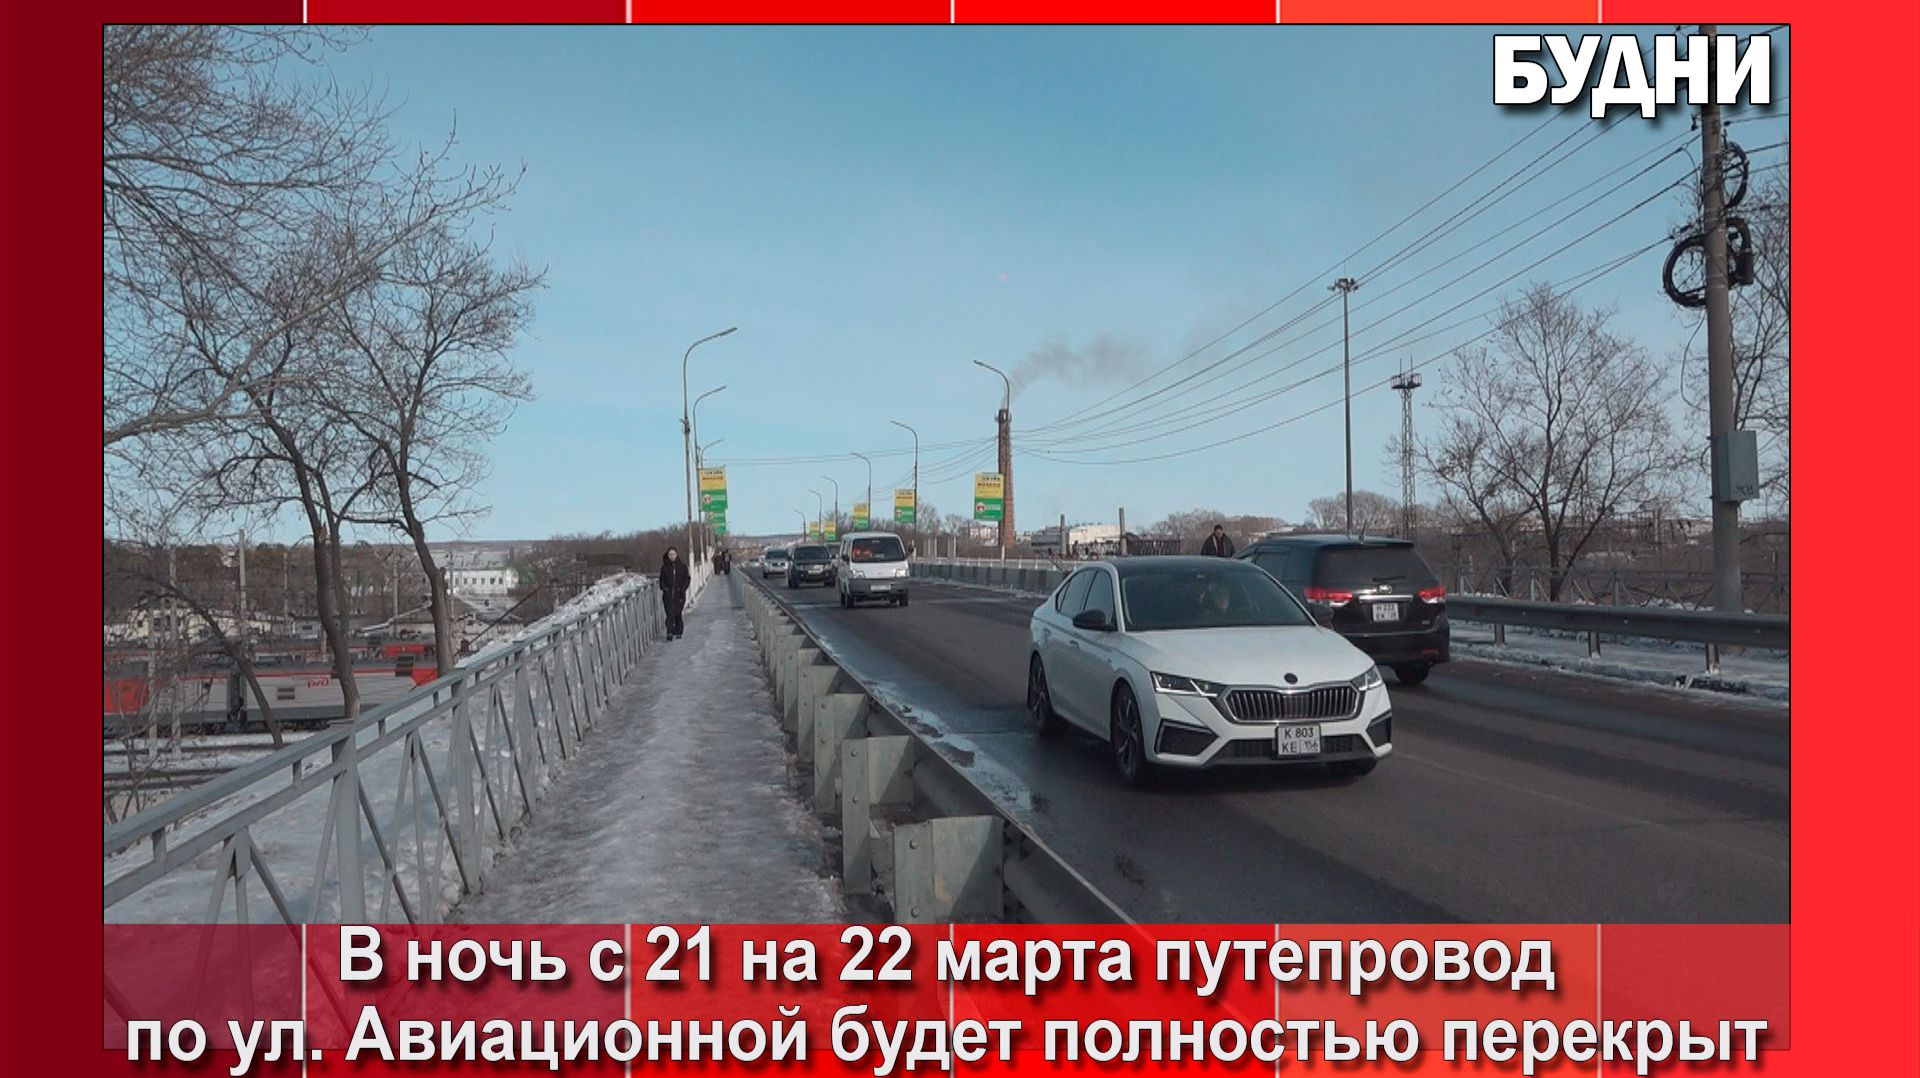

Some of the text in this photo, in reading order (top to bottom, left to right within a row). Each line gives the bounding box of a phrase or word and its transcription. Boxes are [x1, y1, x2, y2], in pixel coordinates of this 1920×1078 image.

[1284, 727, 1314, 739] К 803
[1281, 741, 1297, 753] КЕ
